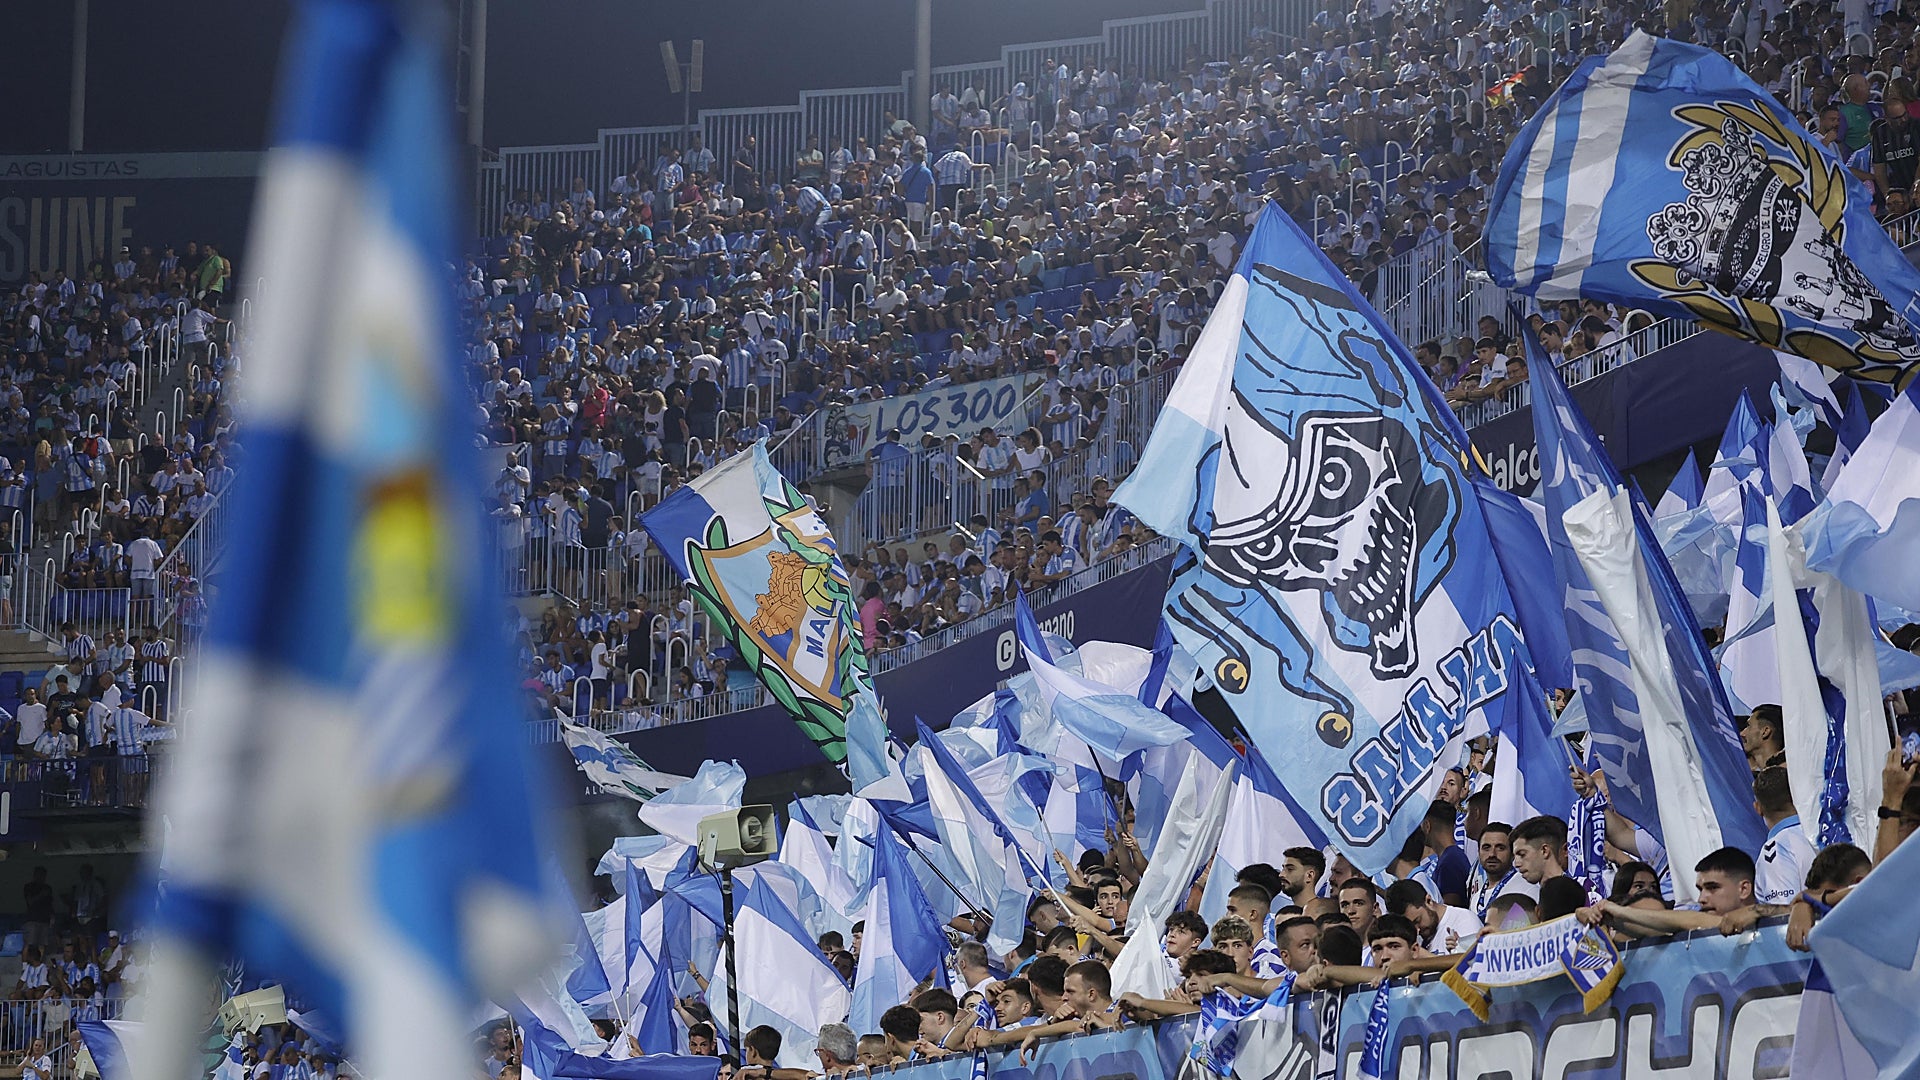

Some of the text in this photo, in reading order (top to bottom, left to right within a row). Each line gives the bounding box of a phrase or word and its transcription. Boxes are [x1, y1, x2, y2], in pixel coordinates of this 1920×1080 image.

[1762, 206, 1770, 217] LA
[1756, 232, 1770, 268] PELIGRO
[1752, 267, 1760, 277] EL
[1742, 278, 1752, 288] EN
[1487, 933, 1531, 948] JUNTOS
